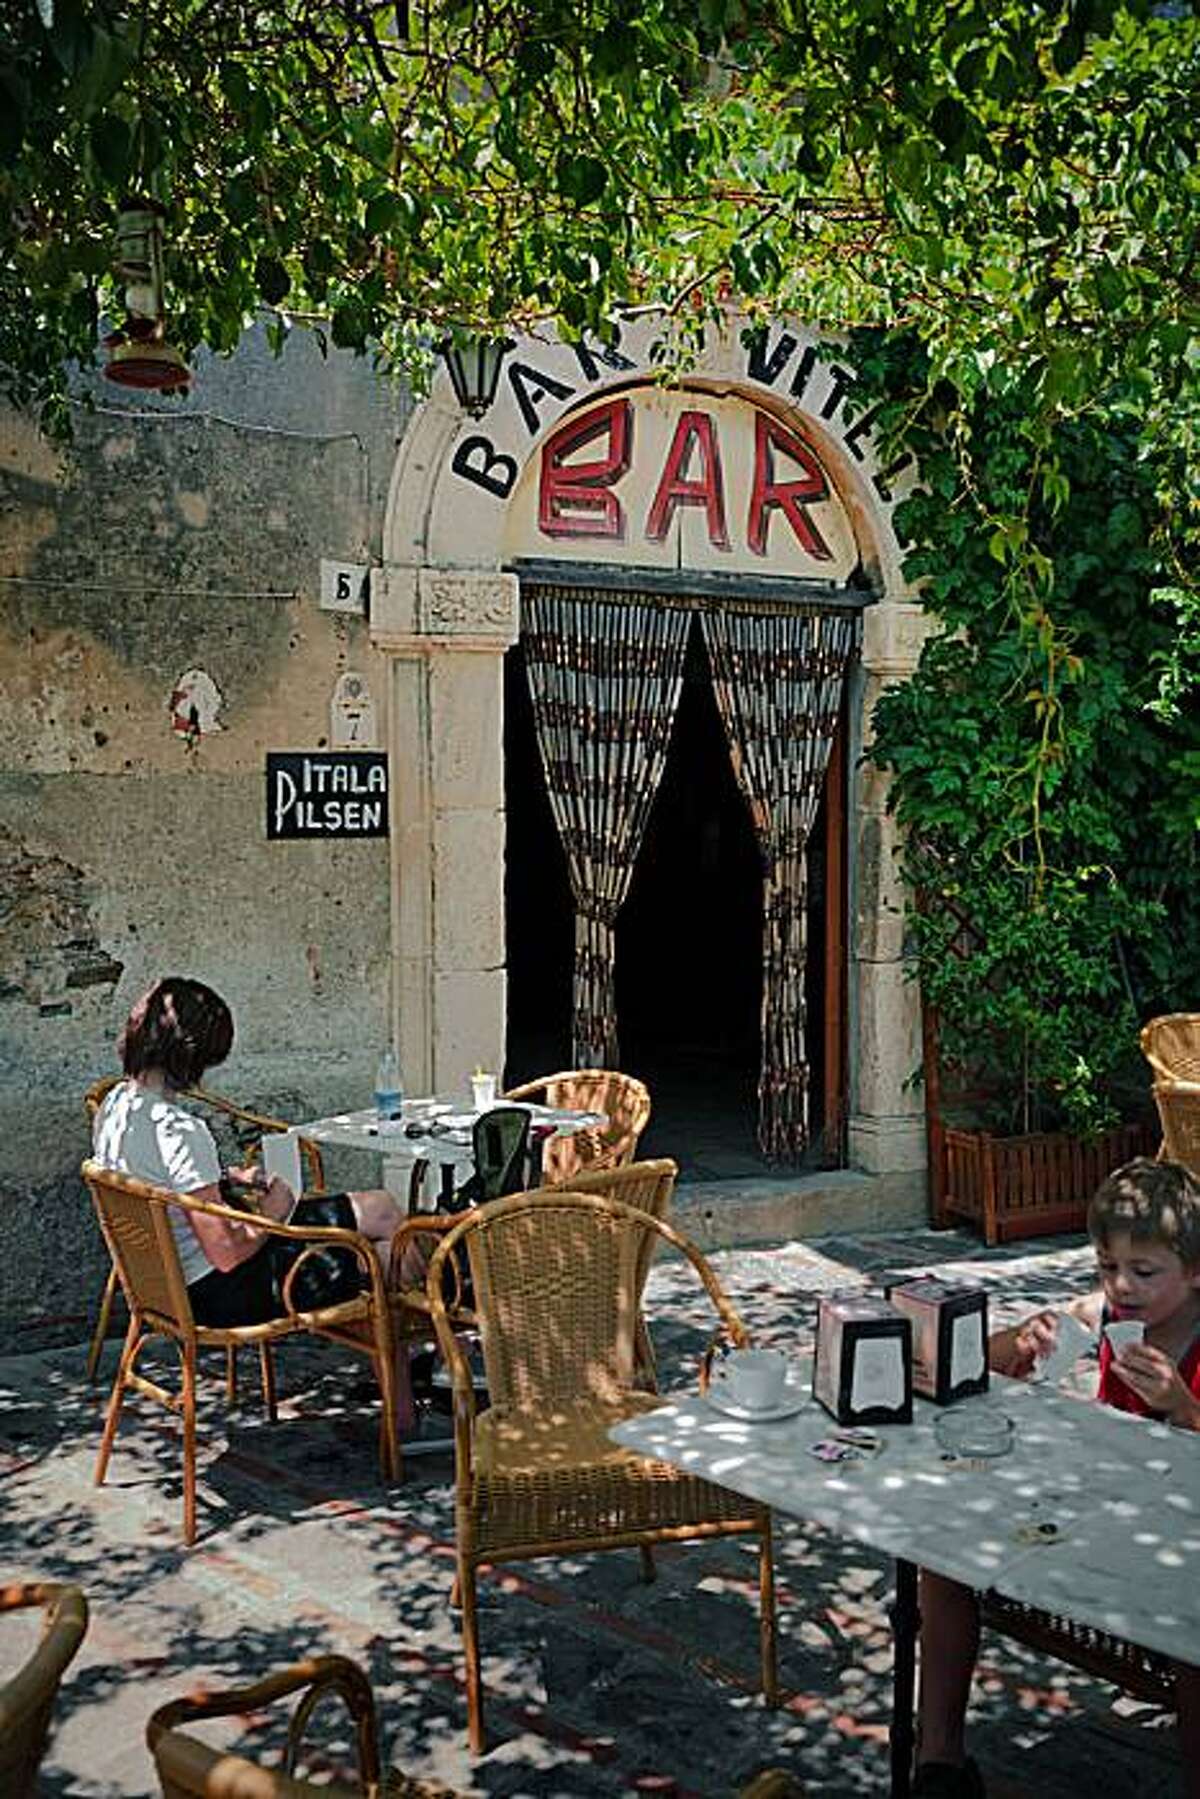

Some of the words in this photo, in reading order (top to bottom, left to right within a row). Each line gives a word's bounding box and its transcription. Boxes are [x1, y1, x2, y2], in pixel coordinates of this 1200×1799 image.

[537, 398, 837, 562] BAR
[275, 770, 382, 834] PILSEN
[302, 758, 387, 793] ITALA
